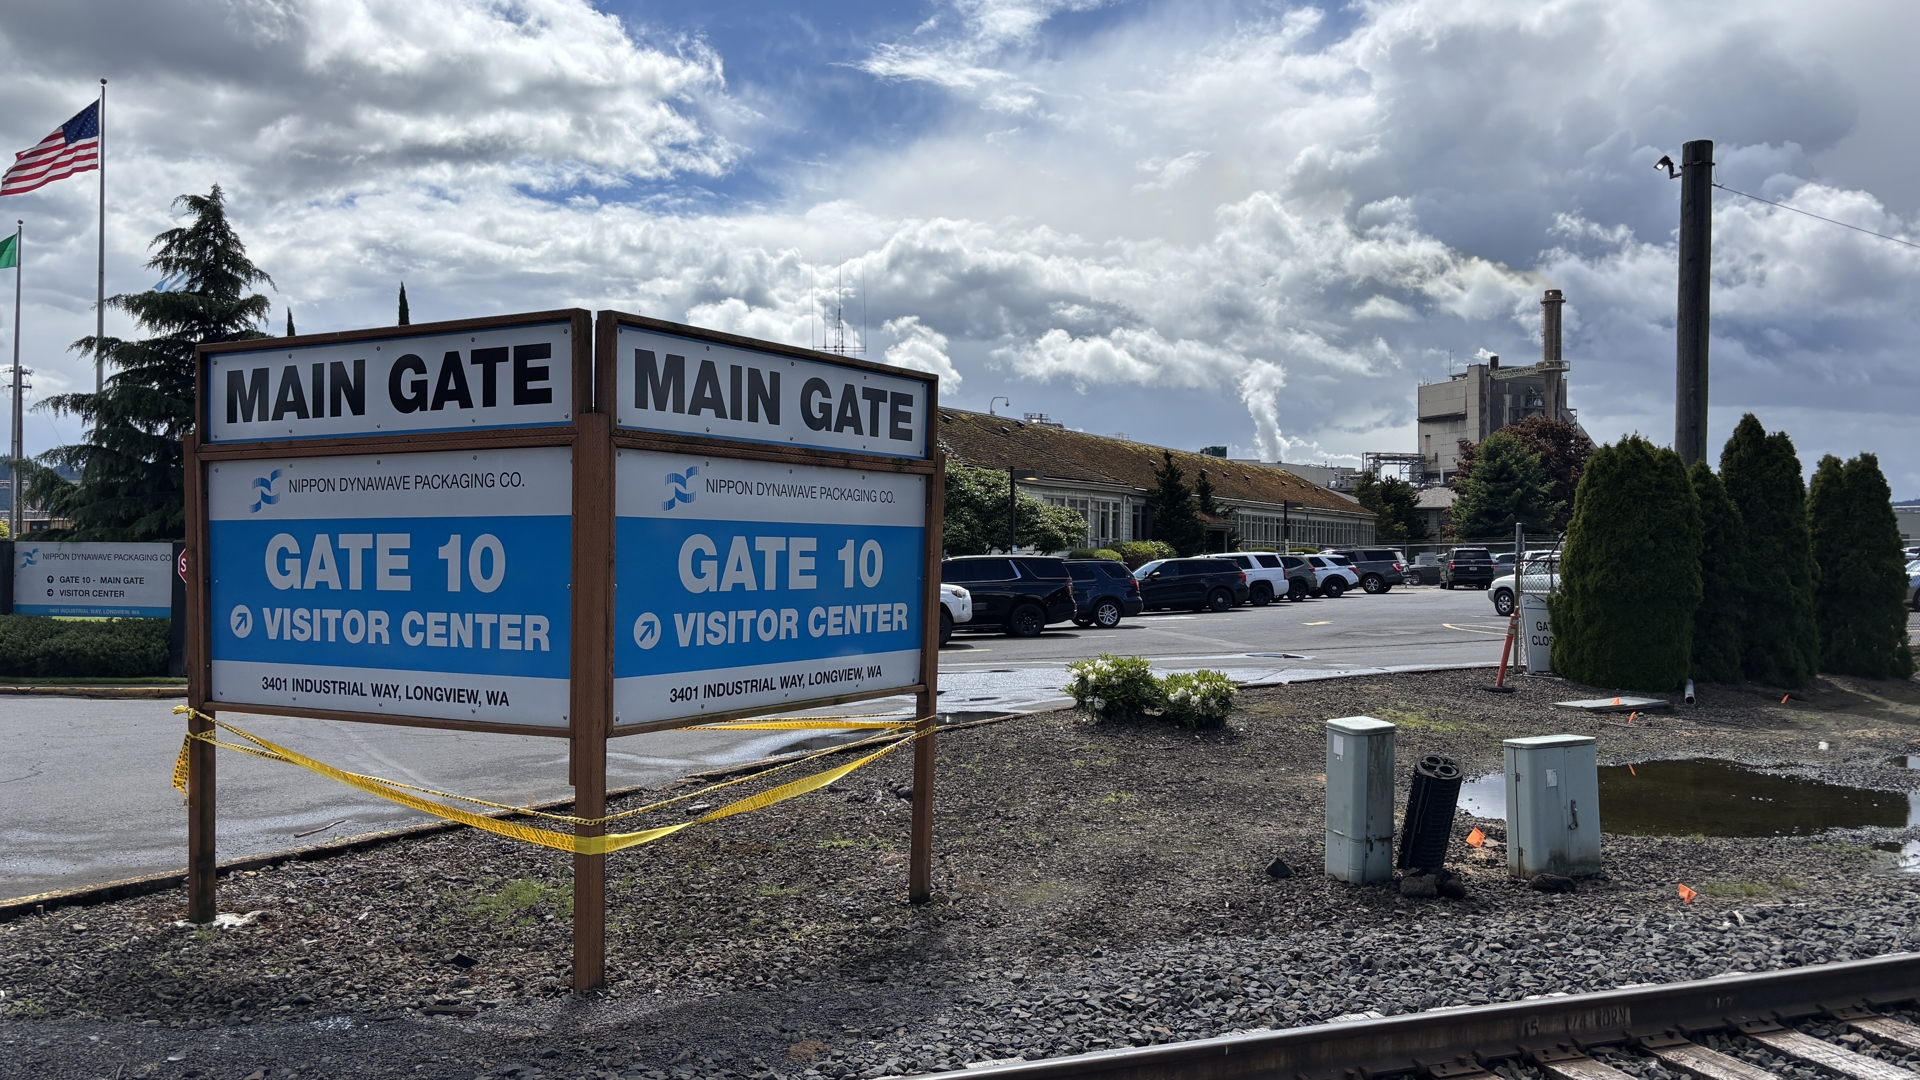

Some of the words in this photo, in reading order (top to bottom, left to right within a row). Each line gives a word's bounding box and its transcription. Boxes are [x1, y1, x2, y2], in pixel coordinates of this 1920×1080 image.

[226, 359, 366, 424] MAIN
[388, 342, 553, 414] GATE
[634, 348, 781, 426] MAIN
[800, 376, 914, 442] GATE
[288, 477, 336, 493] NIPPON
[339, 475, 411, 492] DYNAWAVE
[414, 472, 495, 490] PACKAGING
[499, 471, 525, 488] CO.
[706, 478, 753, 496] NIPPON
[757, 482, 817, 500] DYNAWAVE
[819, 486, 877, 504] PACKAGING
[879, 490, 896, 504] CO.
[71, 553, 112, 561] DYNAWAVE
[265, 532, 411, 591] GATE
[438, 533, 506, 594] 10
[678, 533, 818, 594] GATE
[838, 539, 884, 589] 10
[59, 576, 80, 584] GATE
[81, 576, 91, 584] 10
[123, 577, 145, 585] GATE
[59, 589, 90, 597] VISITOR
[262, 608, 390, 645] VISITOR
[401, 610, 550, 652] CENTER
[674, 608, 798, 648] VISITOR
[808, 602, 908, 639] CENTER
[1532, 635, 1554, 646] CLOS
[1536, 621, 1552, 631] GAT
[262, 676, 288, 692] 3401
[292, 677, 368, 697] INDUSTRIAL
[371, 683, 402, 702] WAY,
[405, 685, 482, 706] LONGVIEW,
[485, 690, 509, 707] WA
[670, 685, 699, 704] 3401
[703, 677, 777, 699] INDUSTRIAL
[779, 674, 806, 691] WAY,
[808, 667, 865, 686] LONGVIEW,
[867, 665, 882, 678] WA
